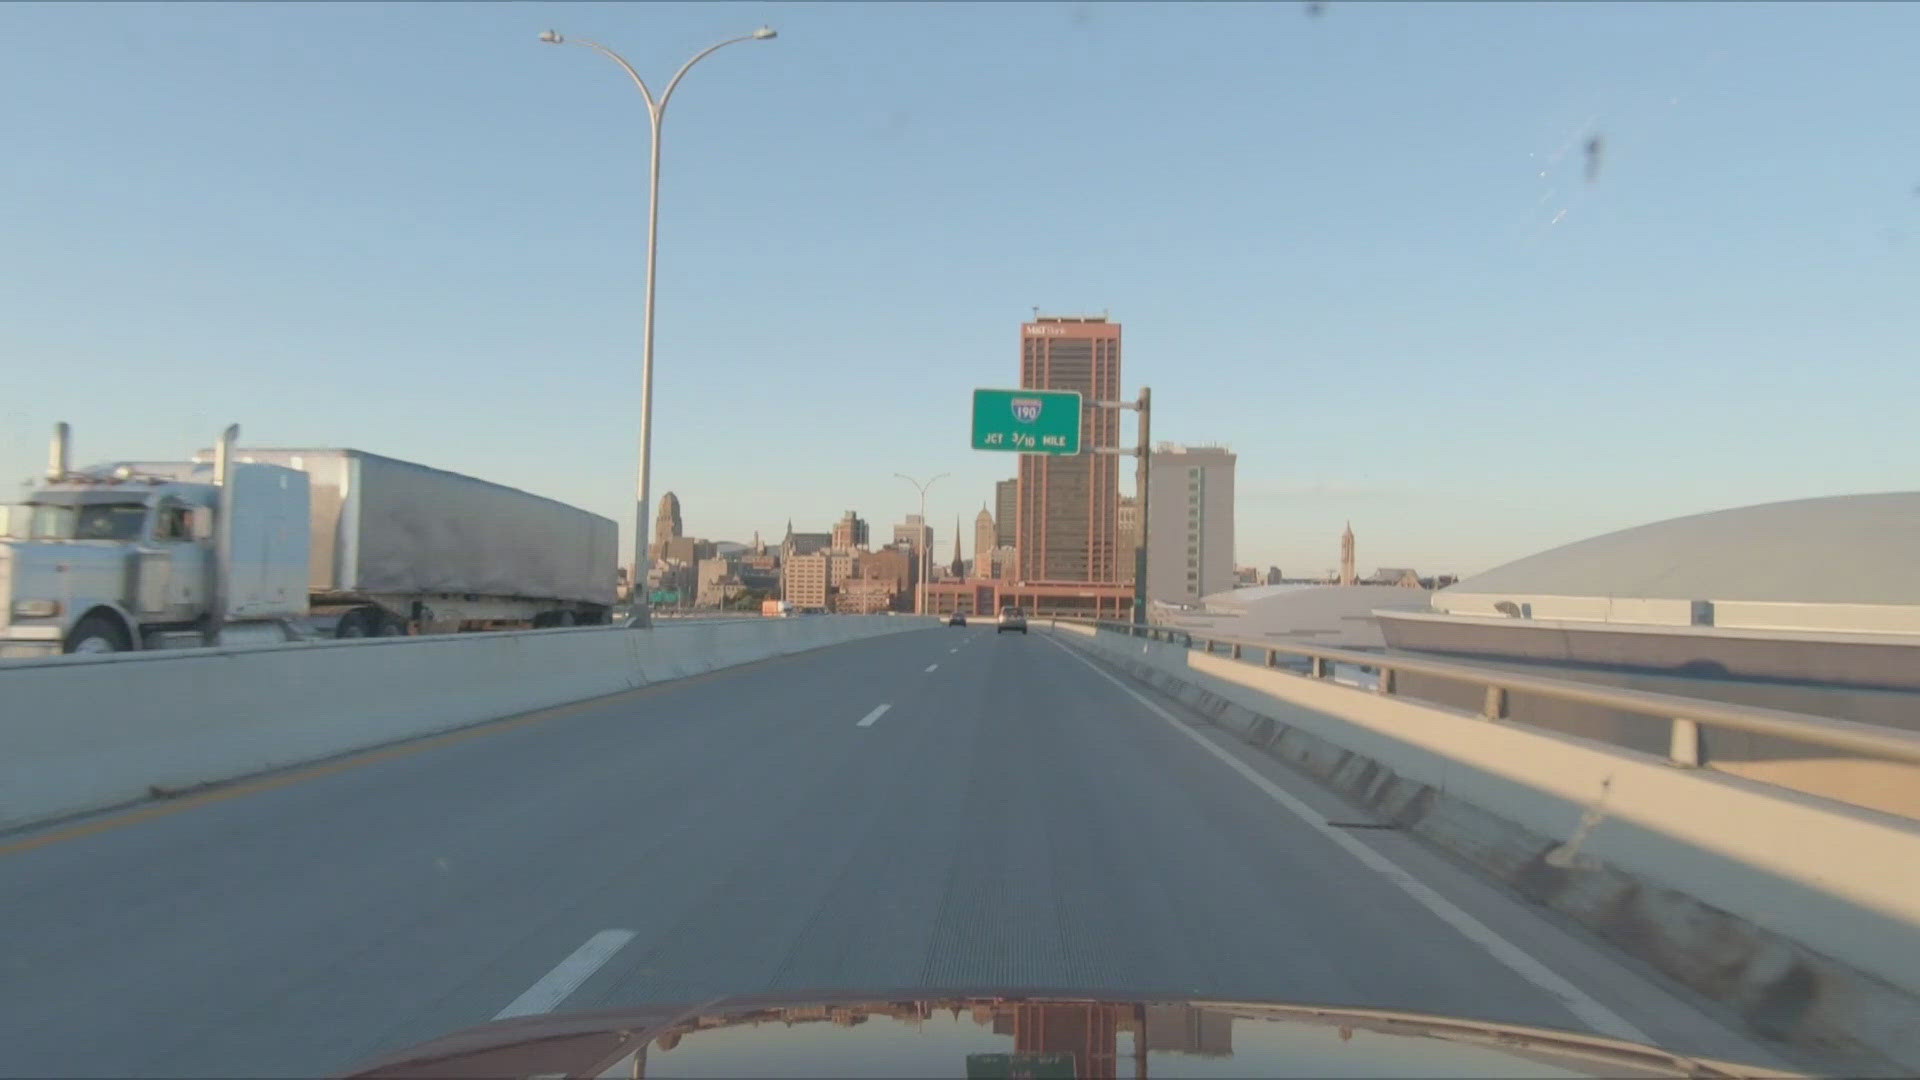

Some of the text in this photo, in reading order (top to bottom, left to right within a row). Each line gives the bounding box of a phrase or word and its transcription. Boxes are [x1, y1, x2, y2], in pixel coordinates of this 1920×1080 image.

[1018, 407, 1036, 419] 190
[984, 432, 1066, 448] JCT 3/10 MILE
